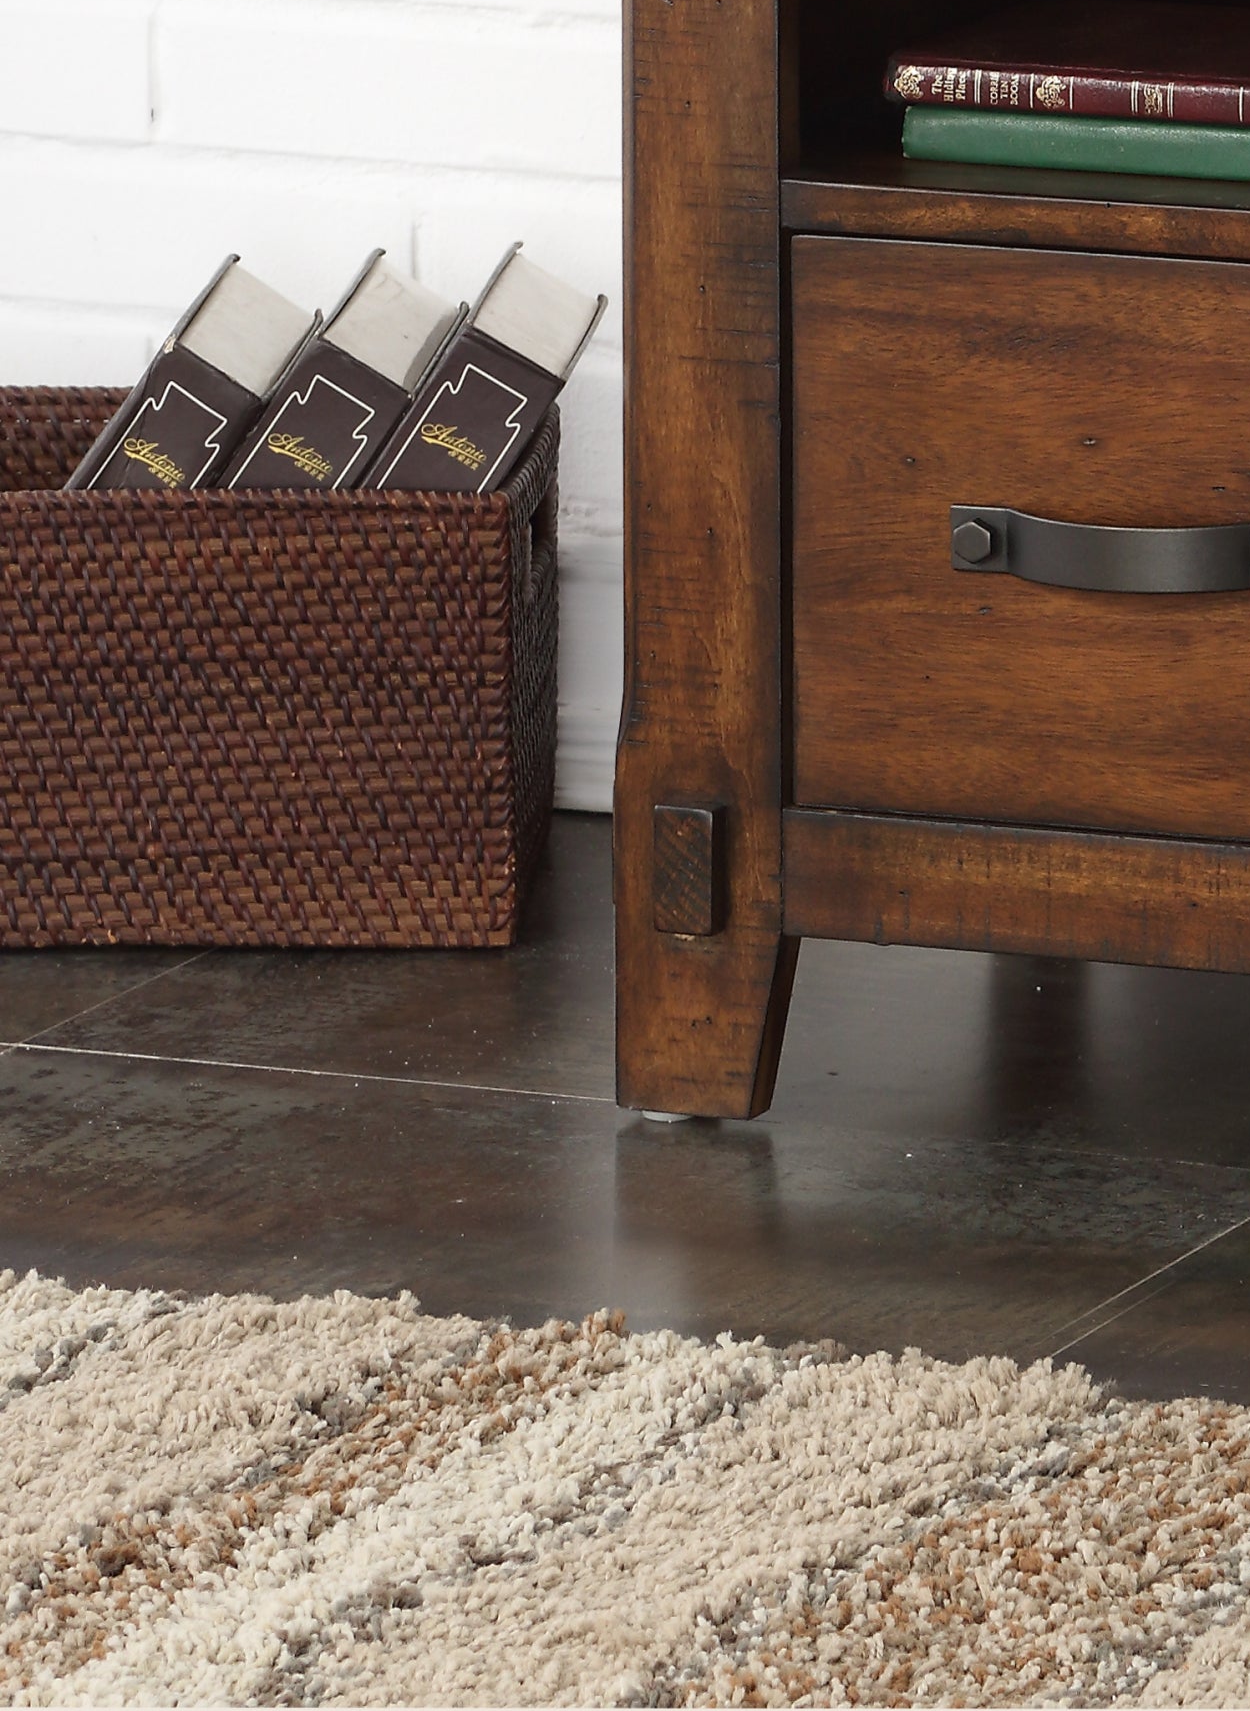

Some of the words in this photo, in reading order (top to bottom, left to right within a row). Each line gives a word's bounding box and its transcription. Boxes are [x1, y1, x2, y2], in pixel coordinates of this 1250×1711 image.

[932, 74, 943, 95] The
[955, 70, 966, 100] Place
[1000, 80, 1009, 99] TEN
[124, 438, 186, 481] Antonio
[268, 433, 333, 473] Antonio
[421, 423, 487, 462] Antonio
